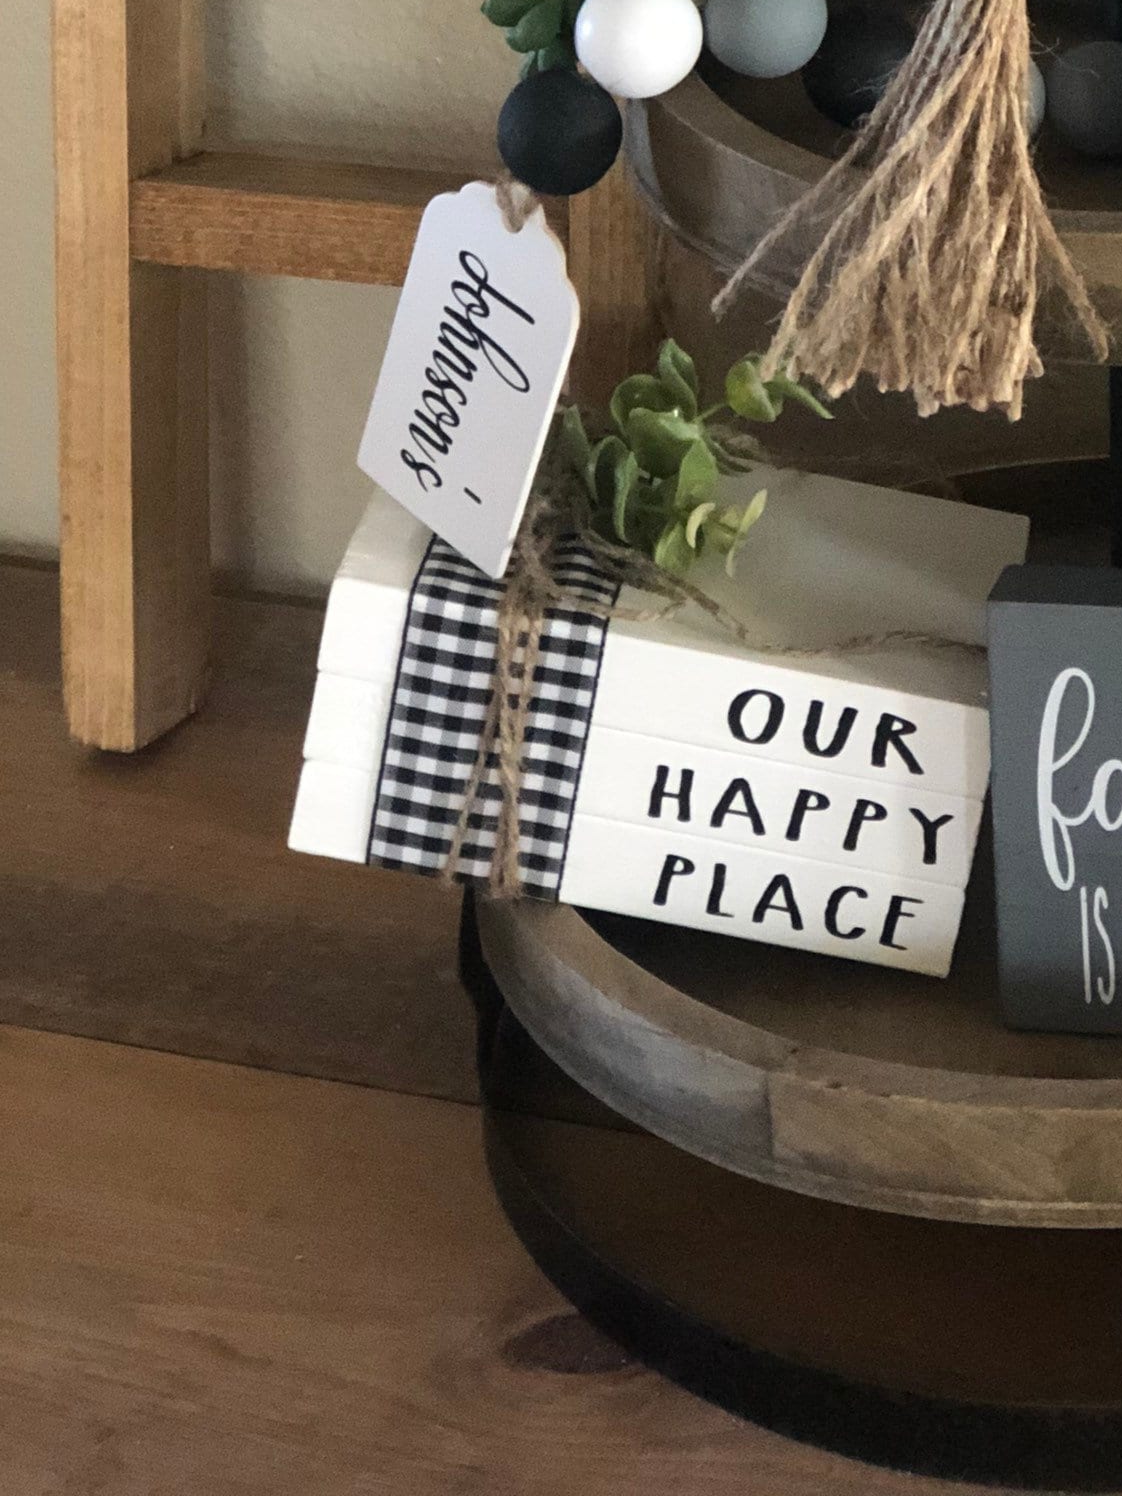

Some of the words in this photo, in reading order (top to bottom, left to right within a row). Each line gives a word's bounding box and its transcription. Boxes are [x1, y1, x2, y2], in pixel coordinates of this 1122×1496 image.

[727, 688, 925, 775] OUR
[647, 764, 955, 866] HAPPY
[653, 854, 924, 951] PLACE
[1080, 886, 1115, 1005] IS
